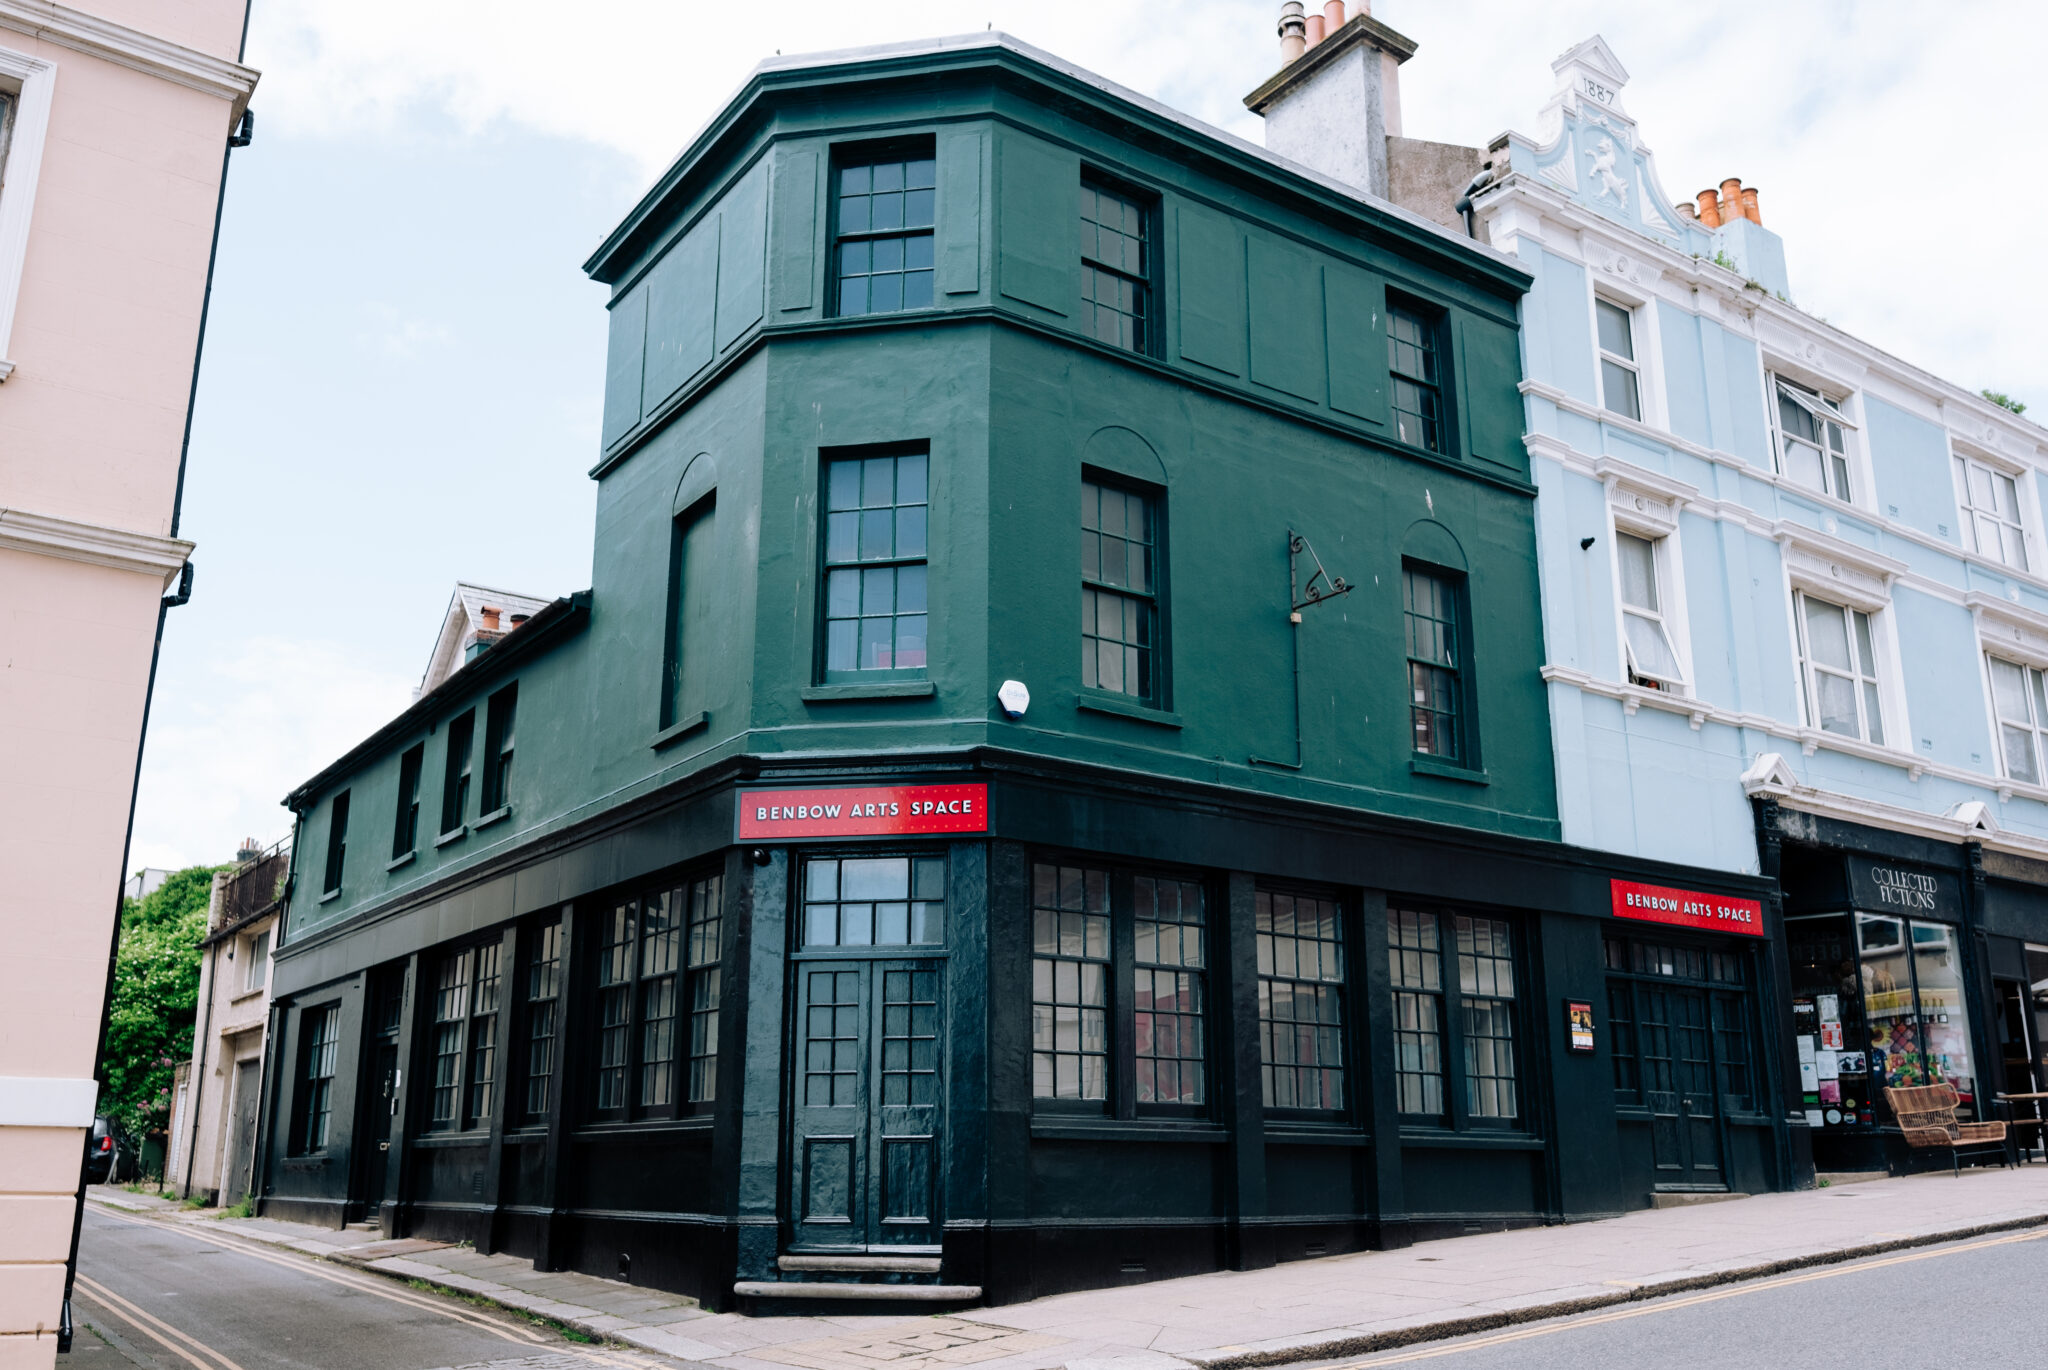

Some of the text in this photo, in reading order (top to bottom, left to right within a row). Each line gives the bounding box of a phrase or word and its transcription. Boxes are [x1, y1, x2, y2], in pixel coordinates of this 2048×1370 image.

[1583, 78, 1614, 105] 1887
[756, 800, 972, 820] BENBOW ARTS SPACE
[1872, 866, 1938, 893] COLLECTED
[1626, 893, 1752, 923] BENBOW ARTS SPACE
[1880, 885, 1935, 910] FICTIONS
